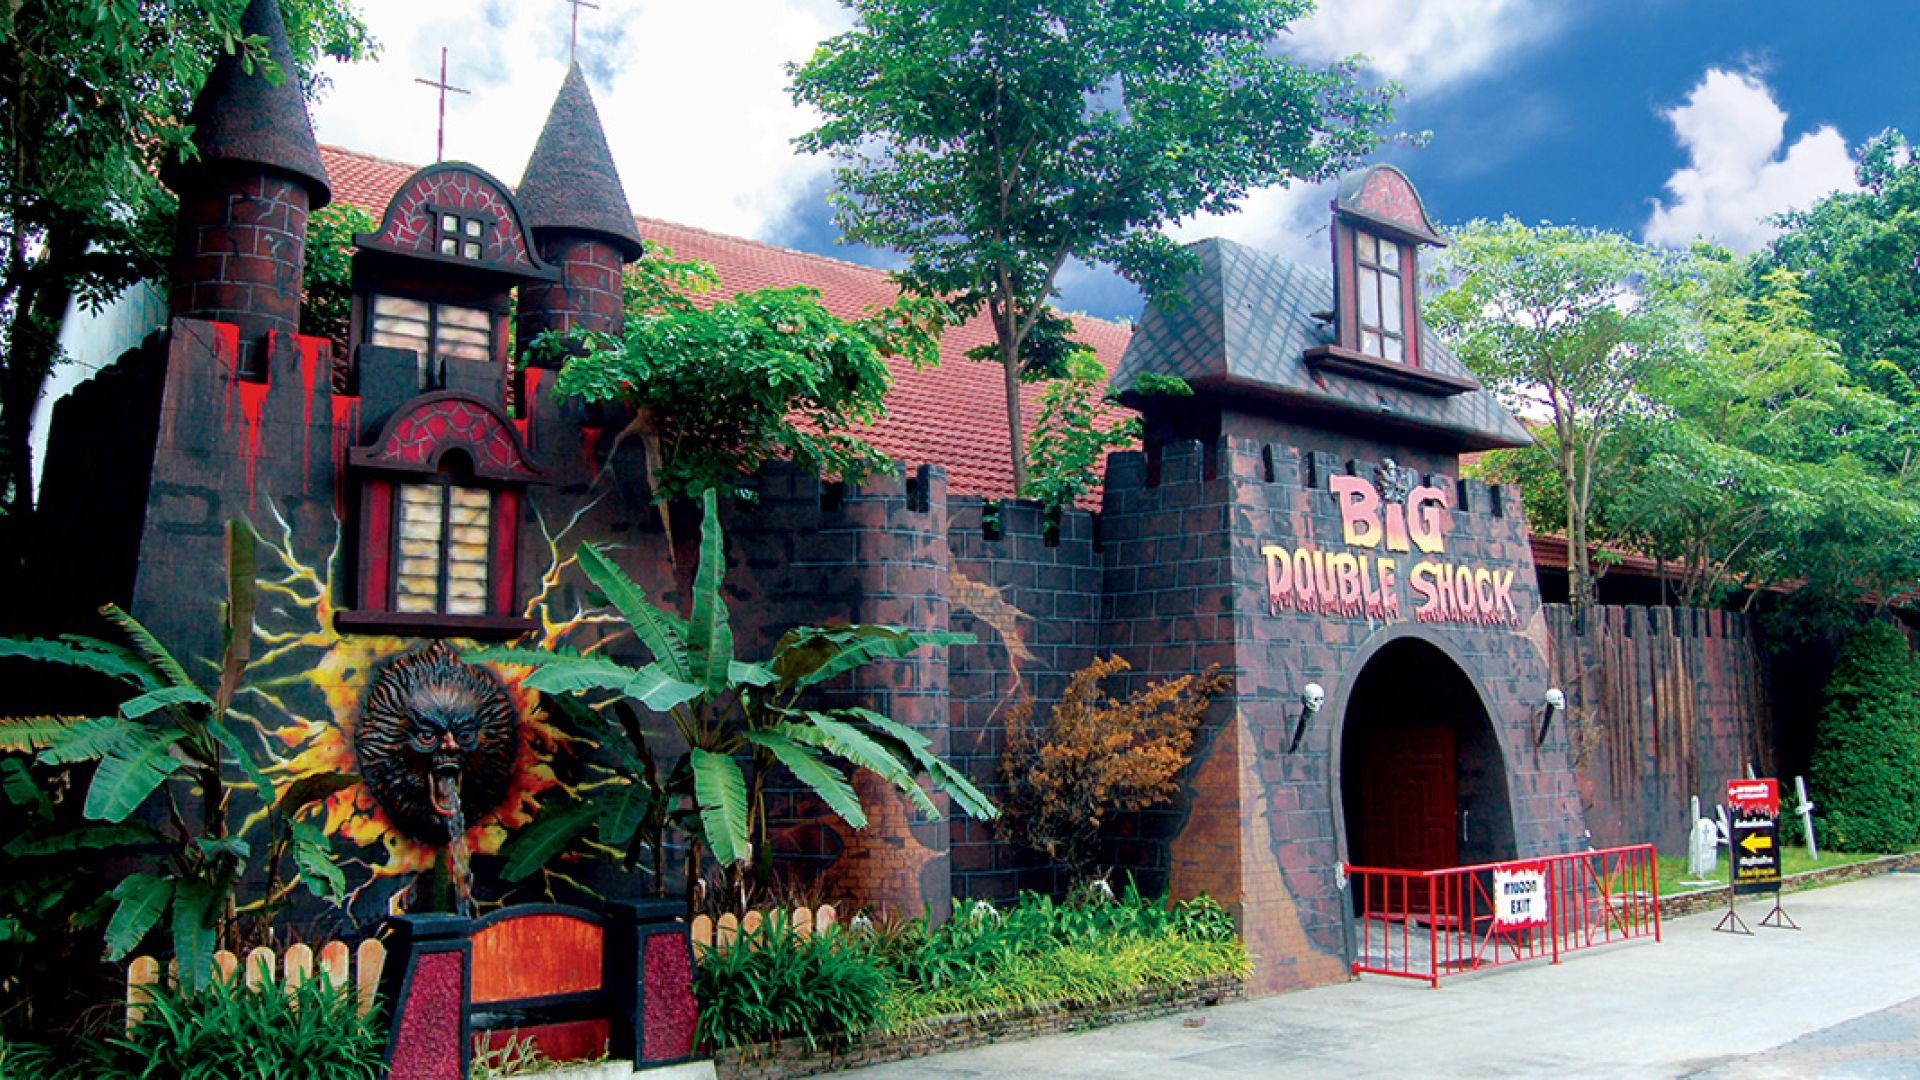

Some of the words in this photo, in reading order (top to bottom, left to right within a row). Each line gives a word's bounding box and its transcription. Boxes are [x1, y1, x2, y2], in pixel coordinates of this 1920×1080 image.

[1262, 545, 1399, 623] DOUBLE
[1409, 560, 1521, 626] SHOCK
[1510, 898, 1530, 915] EXIT
